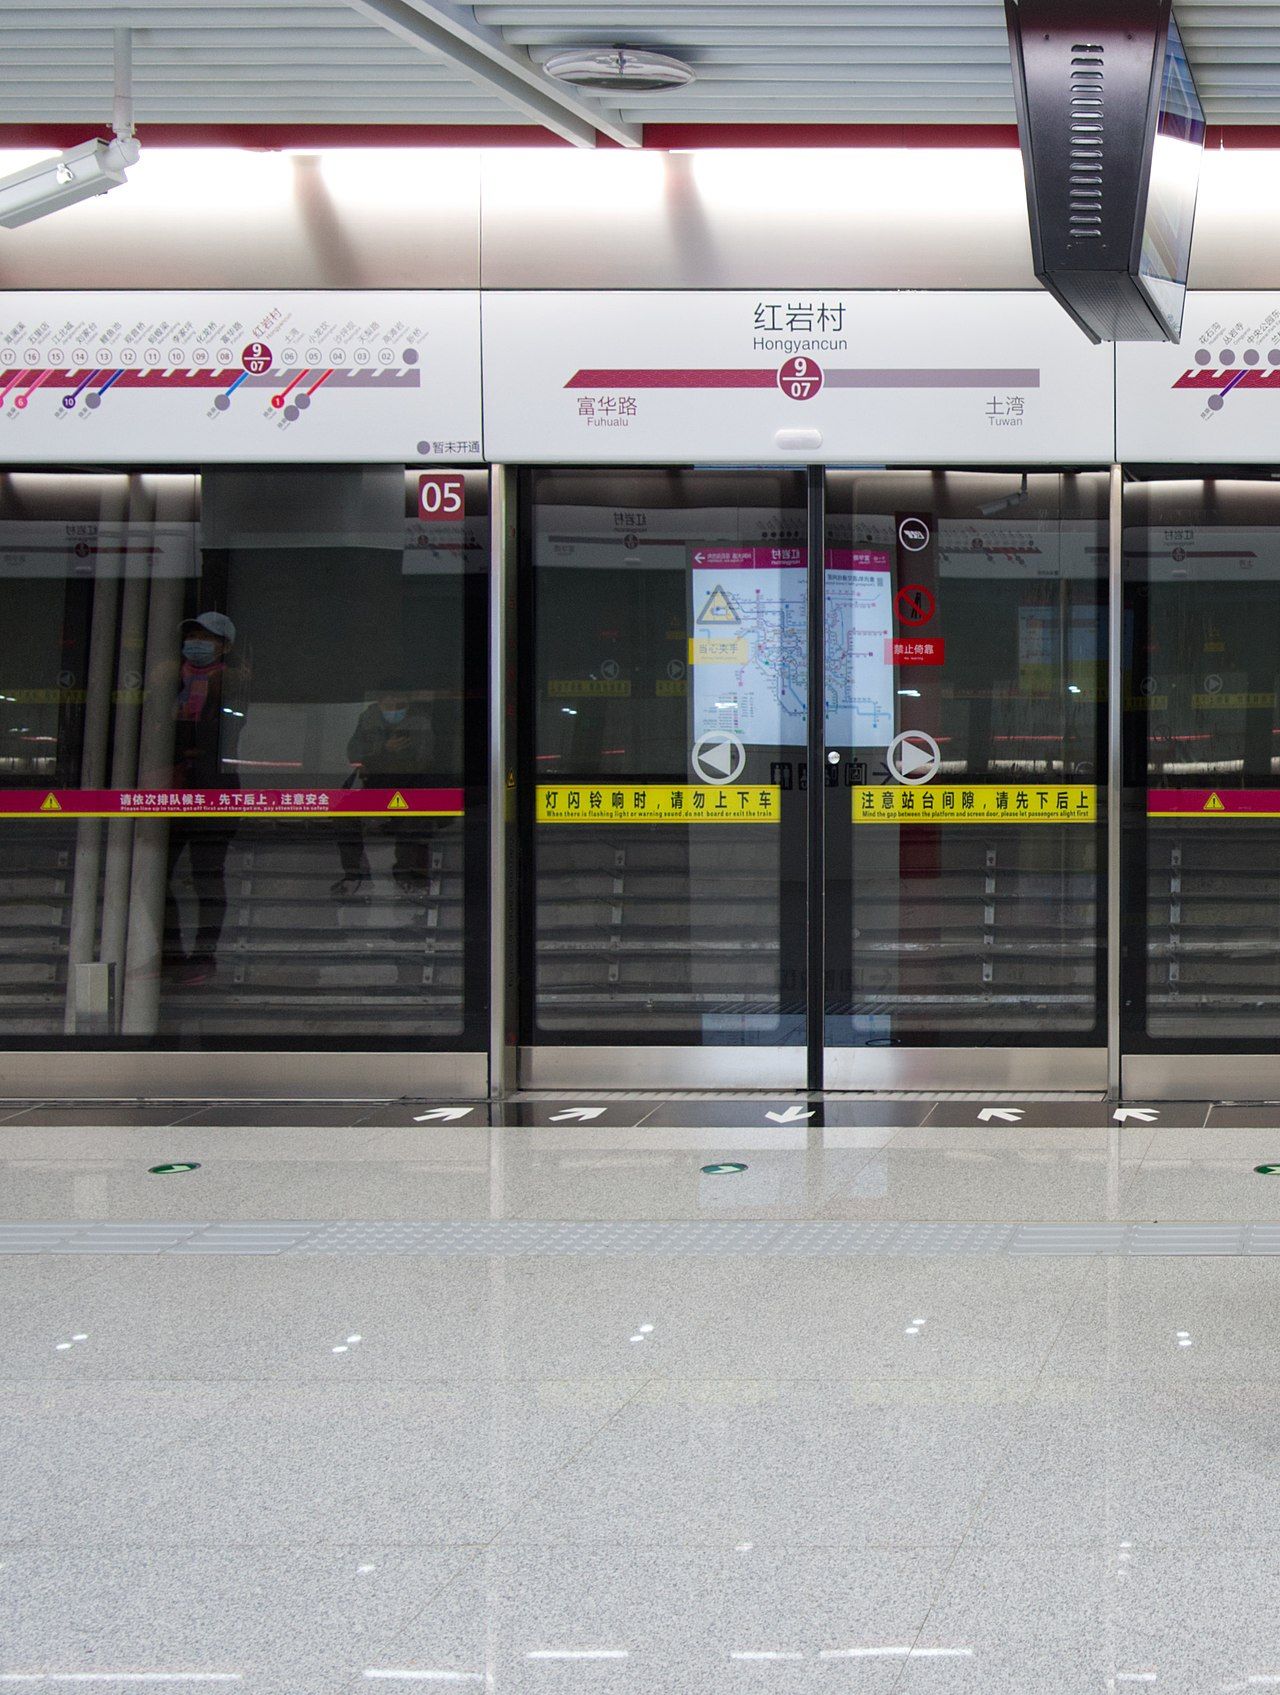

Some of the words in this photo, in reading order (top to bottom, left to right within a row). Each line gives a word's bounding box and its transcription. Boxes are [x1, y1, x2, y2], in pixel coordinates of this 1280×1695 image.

[252, 307, 282, 339] 红岩村
[754, 302, 846, 332] 红岩村
[1246, 309, 1280, 344] 中央公园东
[28, 321, 50, 345] 五里店
[52, 321, 74, 345] 江北城
[76, 322, 97, 345] 刘家台
[100, 321, 122, 344] 鲤鱼池
[124, 321, 145, 344] 观音桥
[172, 321, 193, 344] 李家坪
[196, 321, 217, 344] 化龙桥
[221, 321, 243, 344] 富华路
[284, 327, 300, 344] 土湾
[308, 320, 330, 344] 小龙坎
[334, 321, 356, 344] 沙坪坝
[1199, 322, 1221, 345] 花石沟
[252, 344, 262, 357] 9
[753, 337, 848, 354] Hongyancun
[250, 361, 264, 371] 07
[794, 358, 807, 377] 9
[791, 382, 811, 397] 07
[64, 398, 74, 406] 10
[577, 396, 637, 416] 富华路
[985, 396, 1025, 415] 土湾
[587, 417, 629, 427] Fuhualu
[988, 416, 1023, 426] Tuwan
[432, 441, 480, 454] 暂未开通
[421, 482, 462, 512] 05
[699, 643, 737, 654] 当心夹手
[894, 644, 934, 655] 禁止倚靠
[120, 793, 329, 805] 请依次排队候车，先下后上，注意安全
[545, 791, 772, 809] 灯闪铃响时，请勿上下车
[862, 791, 1089, 809] 注意站台间隙，请先下后上
